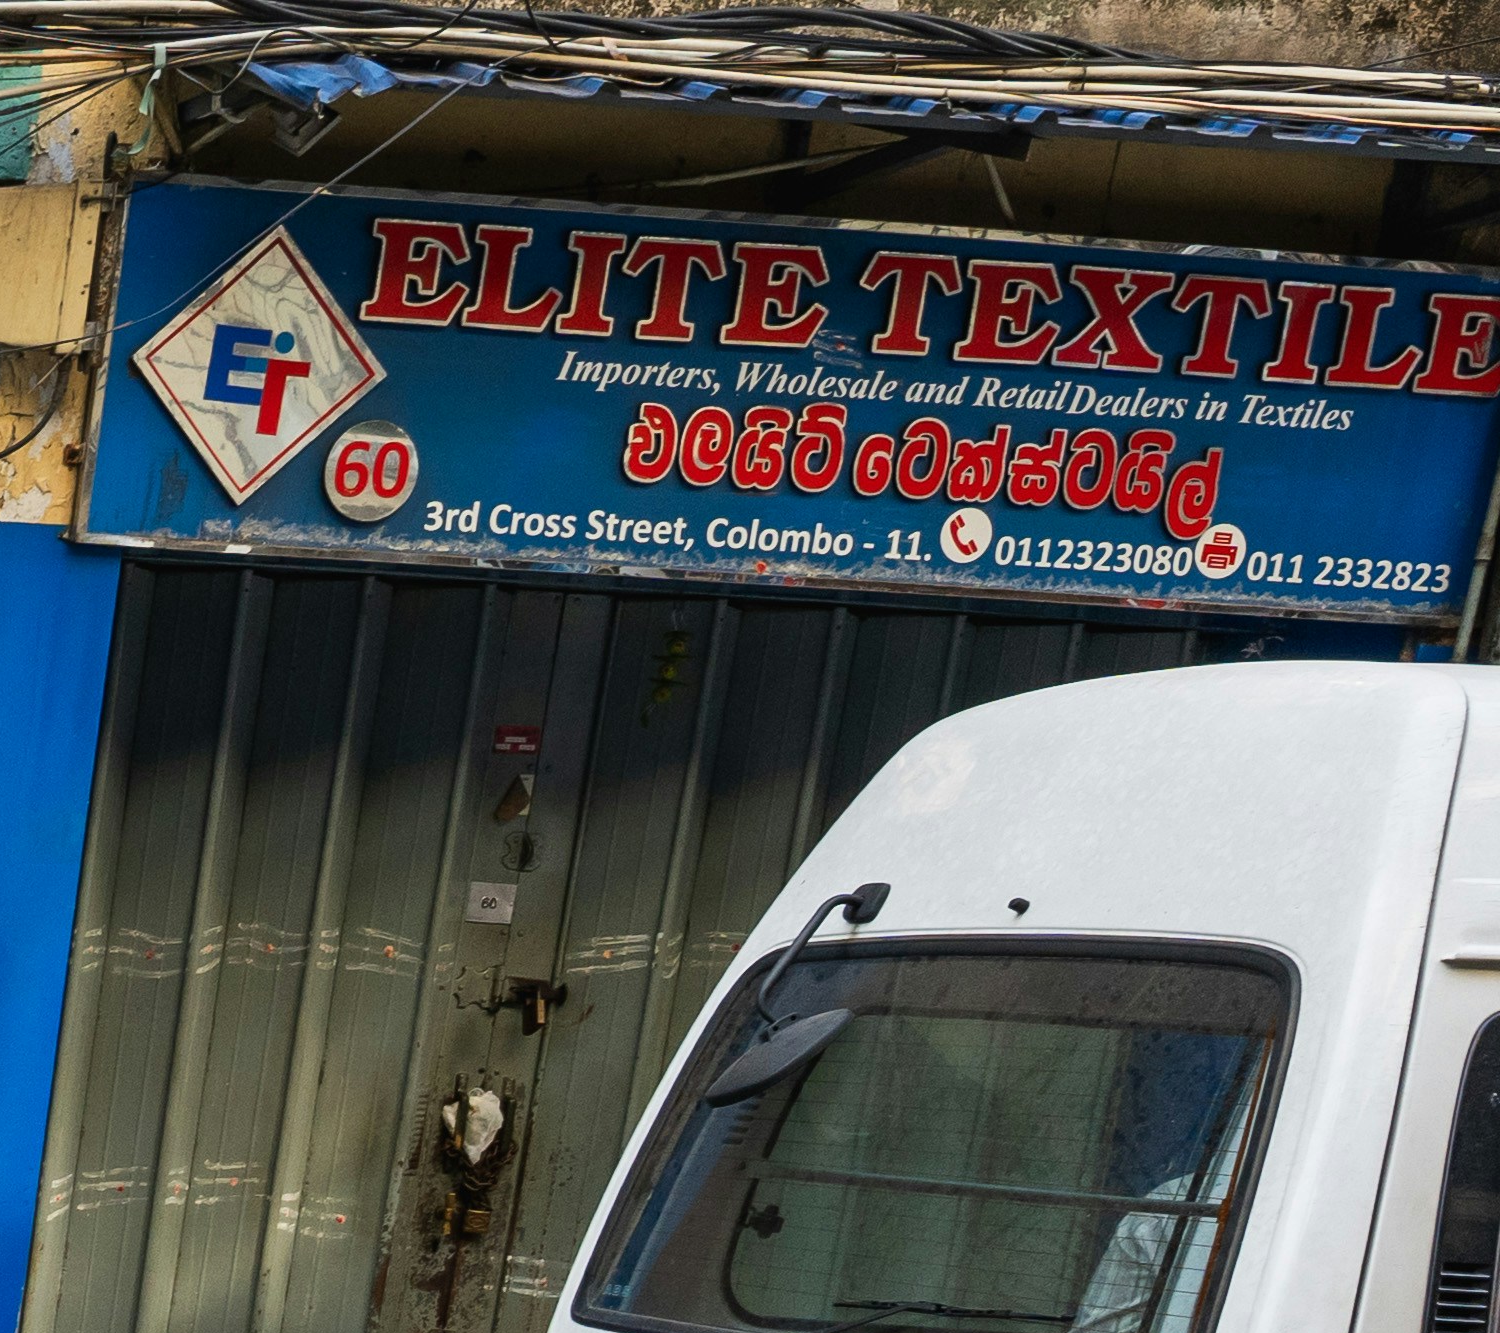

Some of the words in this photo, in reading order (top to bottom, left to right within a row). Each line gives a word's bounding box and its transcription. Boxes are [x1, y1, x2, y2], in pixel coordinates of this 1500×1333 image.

[359, 217, 830, 347] ELITE
[557, 351, 721, 395] Importers,
[735, 362, 897, 401] Wholesale
[905, 376, 970, 405] and
[1195, 392, 1228, 421] in
[1238, 394, 1354, 431] Textiles
[334, 441, 410, 498] 60
[424, 500, 478, 532] 3rd
[488, 504, 576, 539] Cross
[586, 509, 694, 551] Street,
[706, 516, 852, 556] Colombo
[885, 531, 931, 562] 11.
[994, 535, 1192, 577] 0112323080
[1246, 551, 1303, 584] 011
[1313, 555, 1451, 594] 2332823
[481, 897, 497, 909] 60
